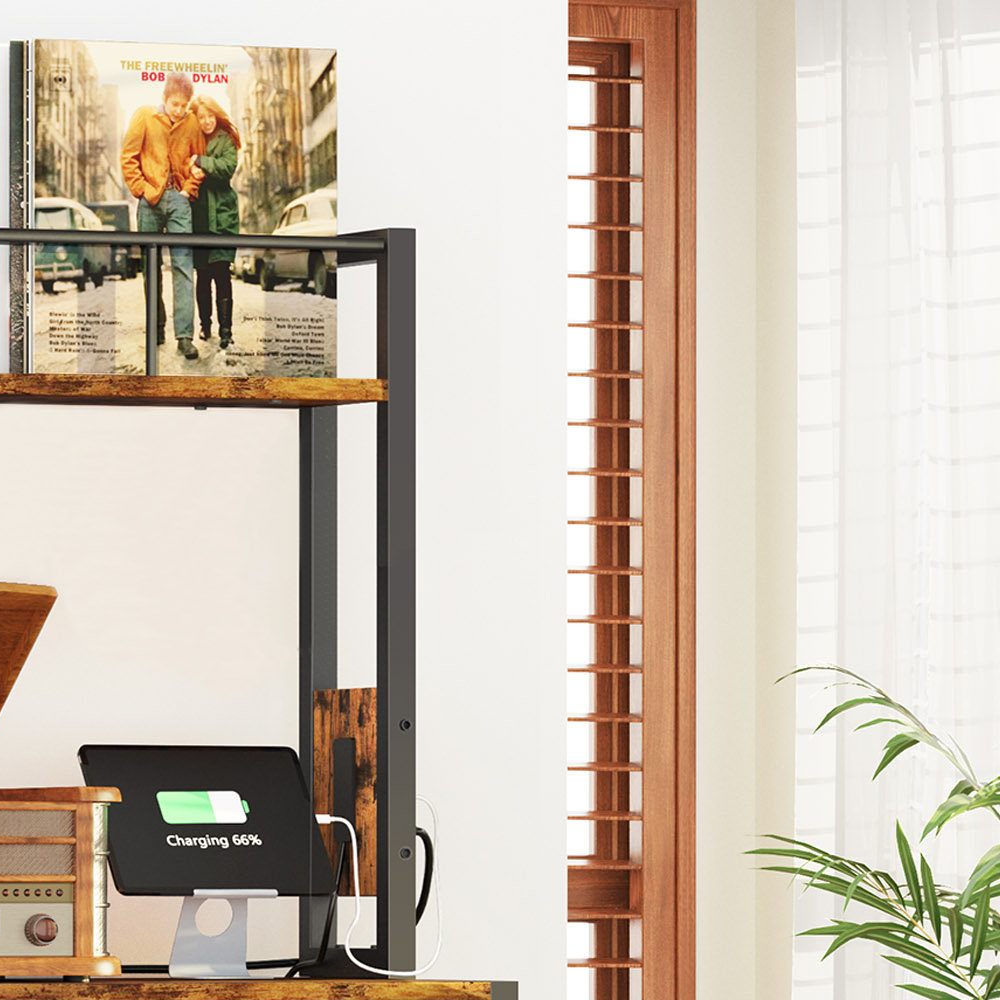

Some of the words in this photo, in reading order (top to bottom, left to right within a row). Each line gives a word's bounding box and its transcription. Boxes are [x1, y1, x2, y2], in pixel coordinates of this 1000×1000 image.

[120, 60, 141, 71] THE
[145, 61, 228, 73] FREEWHEELIN'
[141, 71, 166, 82] BOB
[192, 73, 229, 84] DYLAN
[166, 833, 230, 849] Charging
[231, 833, 263, 847] 66%
